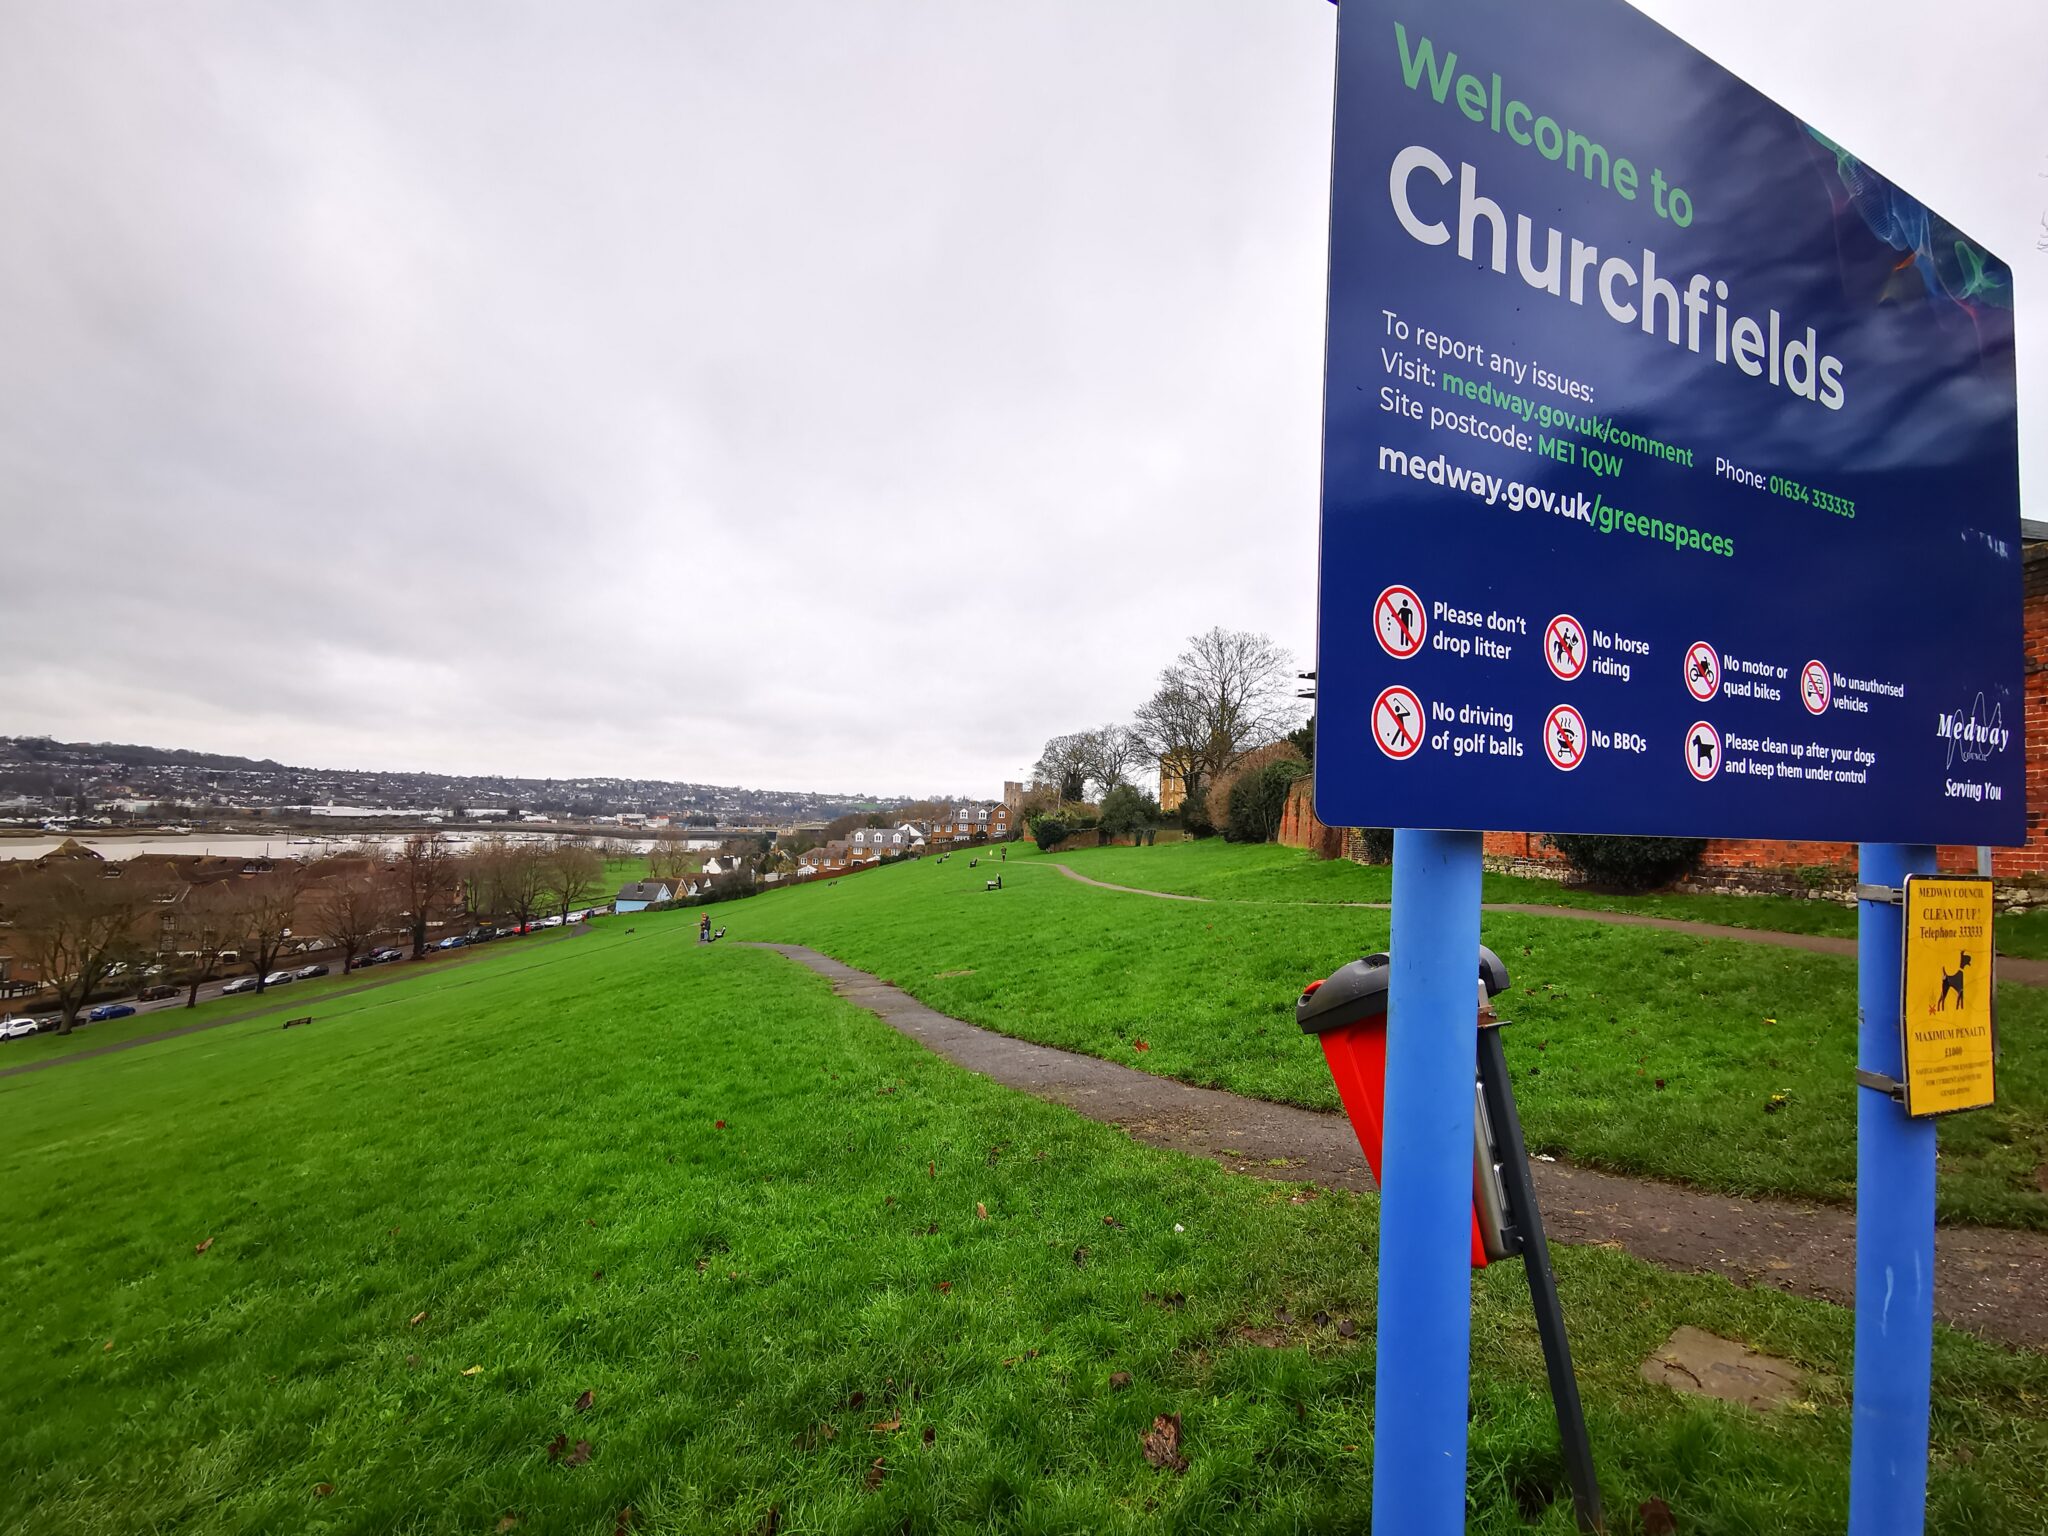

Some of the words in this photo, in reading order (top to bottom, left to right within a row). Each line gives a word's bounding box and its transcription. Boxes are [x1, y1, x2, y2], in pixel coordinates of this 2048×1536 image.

[1394, 21, 1639, 200] Welcome
[1651, 168, 1693, 228] to
[1390, 145, 1845, 410] Churchfields
[1382, 310, 1409, 341] To
[1416, 322, 1483, 366] report
[1490, 350, 1527, 384] any
[1532, 361, 1595, 403] issues:
[1381, 347, 1436, 388] Visit:
[1443, 369, 1694, 468] medway.gov.uk/comment
[1380, 386, 1423, 419] Site
[1431, 403, 1533, 453] postcode:
[1538, 435, 1575, 465] ME1
[1581, 446, 1624, 478] 1QW
[1715, 456, 1767, 491] Phone:
[1769, 475, 1810, 503] 01634
[1812, 489, 1856, 519] 333333
[1379, 446, 1734, 558] medway.gov.uk/greenspaces
[1433, 601, 1482, 627] Please
[1487, 610, 1527, 635] don’t
[1432, 631, 1470, 657] drop
[1474, 636, 1511, 660] litter
[1592, 630, 1612, 649] No
[1614, 633, 1650, 655] horse
[1592, 656, 1631, 682] riding
[1723, 654, 1740, 672] No
[1742, 660, 1774, 678] motor
[1776, 665, 1788, 680] or
[1723, 680, 1751, 699] quad
[1753, 682, 1781, 701] bikes
[1833, 672, 1847, 689] No
[1848, 676, 1905, 698] unauthorised
[1432, 701, 1455, 722] No
[1459, 704, 1513, 732] driving
[1833, 695, 1868, 713] vehicles
[1431, 731, 1449, 751] of
[1453, 733, 1486, 758] golf
[1489, 735, 1524, 757] balls
[1591, 730, 1610, 749] No
[1613, 731, 1647, 753] BBQs
[1936, 713, 2009, 752] Medway
[1725, 733, 1759, 752] Please
[1761, 736, 1788, 755] clean
[1790, 743, 1803, 760] up
[1805, 740, 1829, 759] after
[1831, 746, 1852, 763] your
[1854, 744, 1875, 765] dogs
[1725, 758, 1746, 774] and
[1749, 760, 1775, 780] keep
[1777, 762, 1803, 779] them
[1805, 764, 1832, 782] under
[1835, 768, 1867, 784] control
[1945, 778, 1982, 802] Serving
[1984, 782, 2002, 800] You
[1919, 887, 1951, 898] MEDWAY
[1953, 887, 1984, 898] COUNCIL
[1923, 907, 1953, 920] CLEAN
[1956, 908, 1964, 920] IT
[1919, 926, 1957, 941] Telephone
[1914, 1029, 1954, 1042] MAXIMUM
[1955, 1026, 1986, 1039] PENALTY
